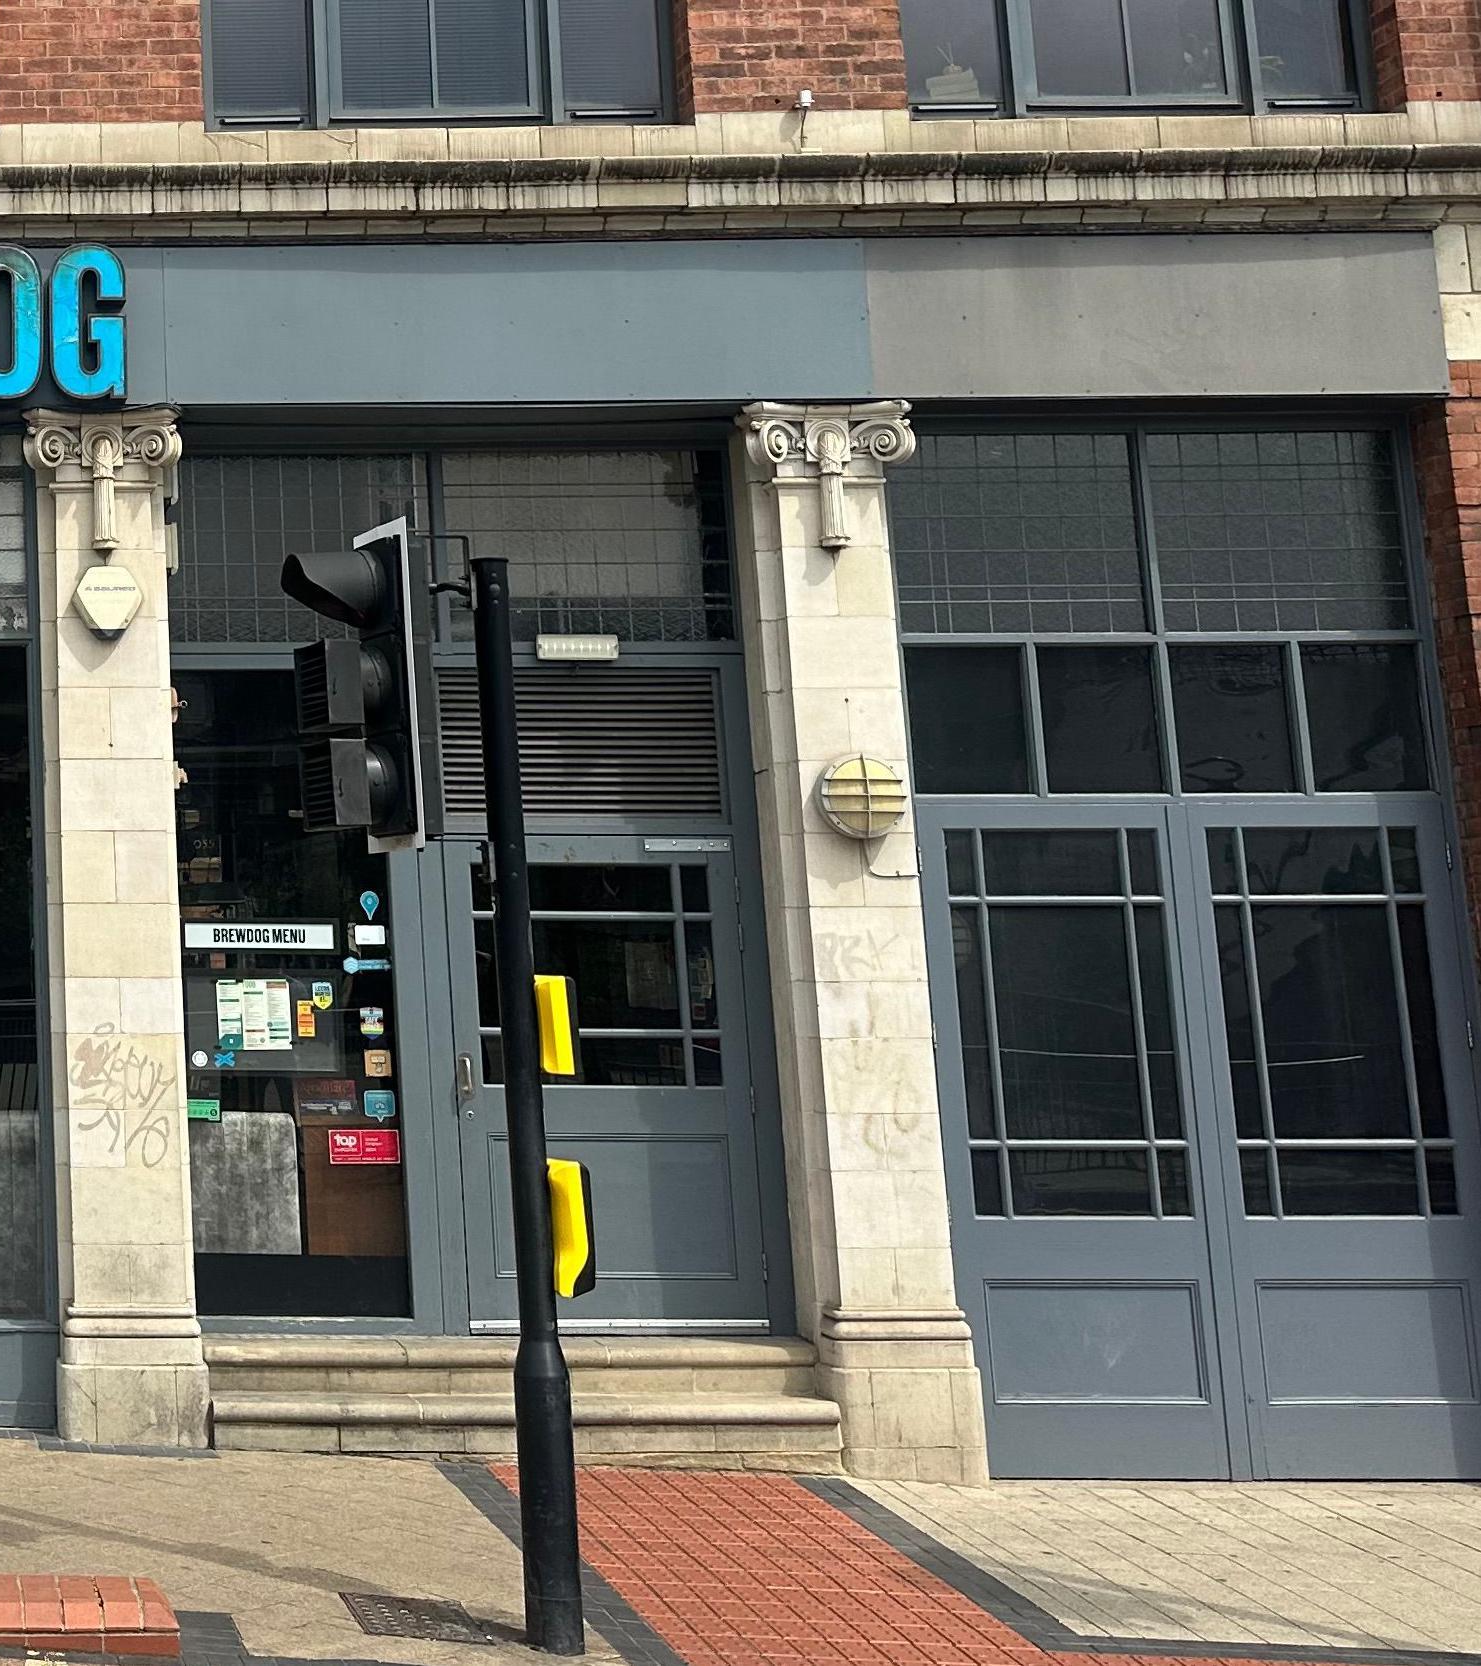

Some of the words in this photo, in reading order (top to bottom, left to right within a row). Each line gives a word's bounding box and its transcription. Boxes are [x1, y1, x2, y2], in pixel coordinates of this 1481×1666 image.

[212, 928, 270, 943] BREWDOG
[271, 928, 306, 943] MENU
[333, 1133, 357, 1147] top
